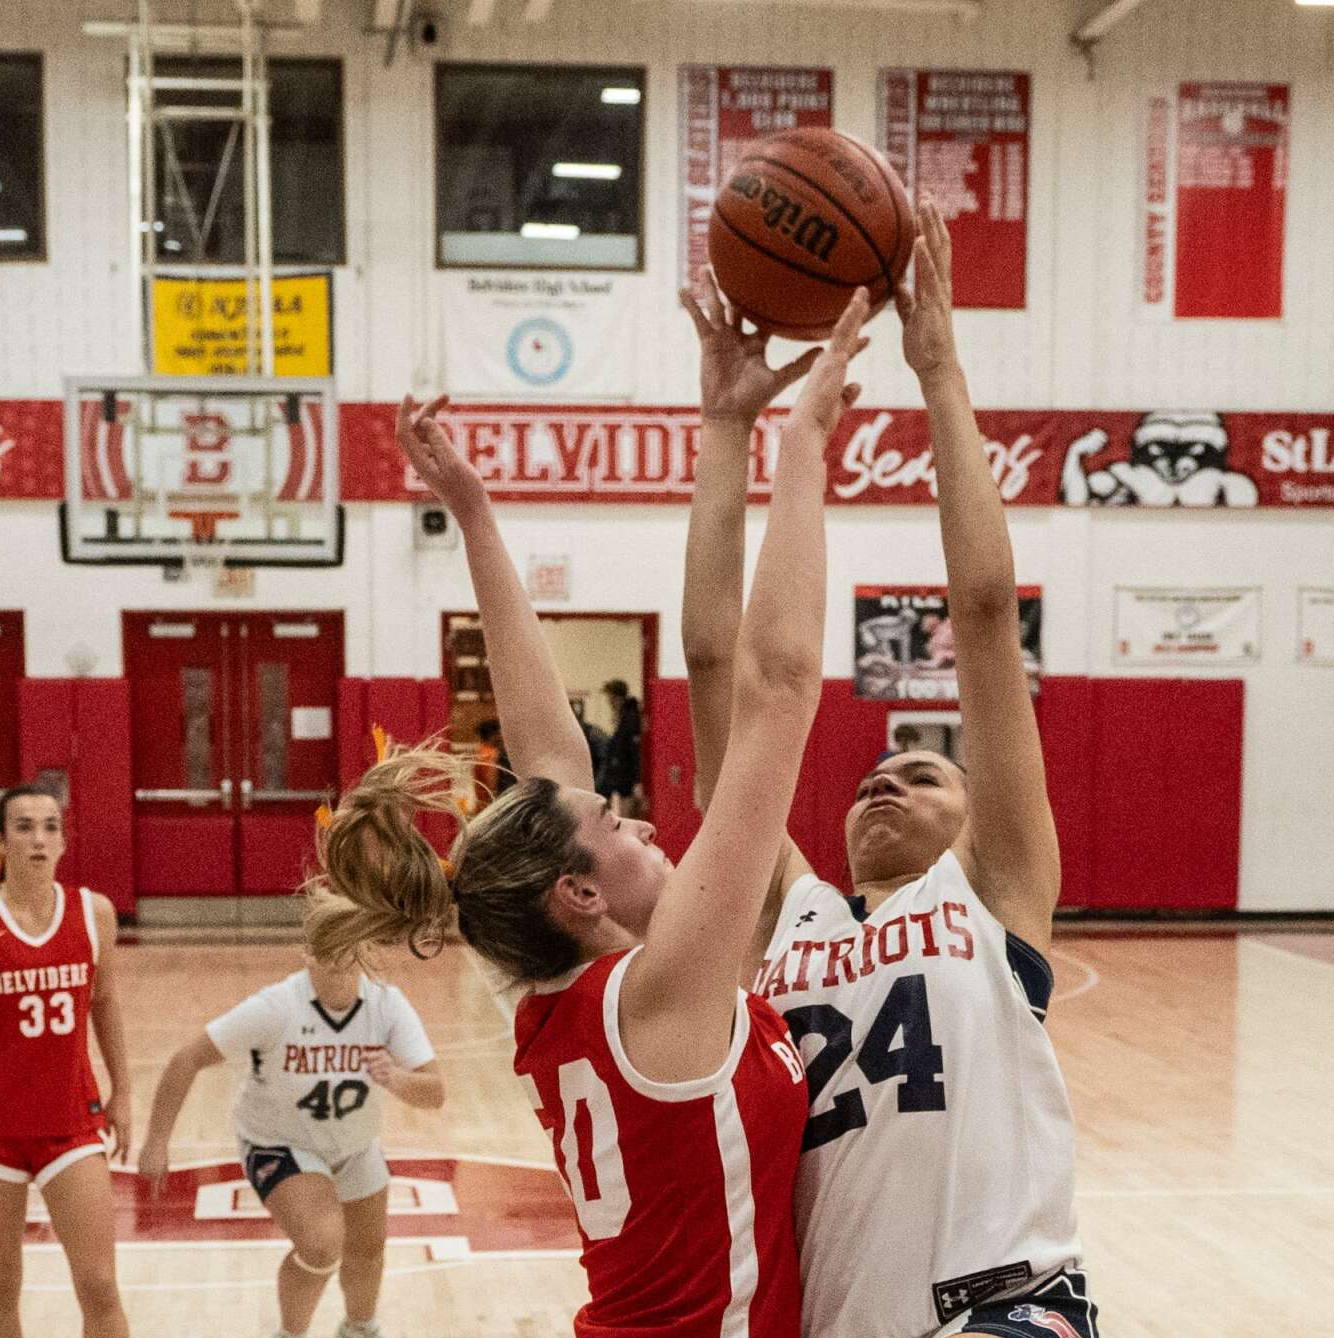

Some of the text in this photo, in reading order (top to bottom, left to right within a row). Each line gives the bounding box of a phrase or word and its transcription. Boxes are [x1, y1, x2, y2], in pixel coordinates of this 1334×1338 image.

[18, 992, 76, 1038] 33
[795, 973, 947, 1153] 24
[297, 1079, 370, 1121] 40
